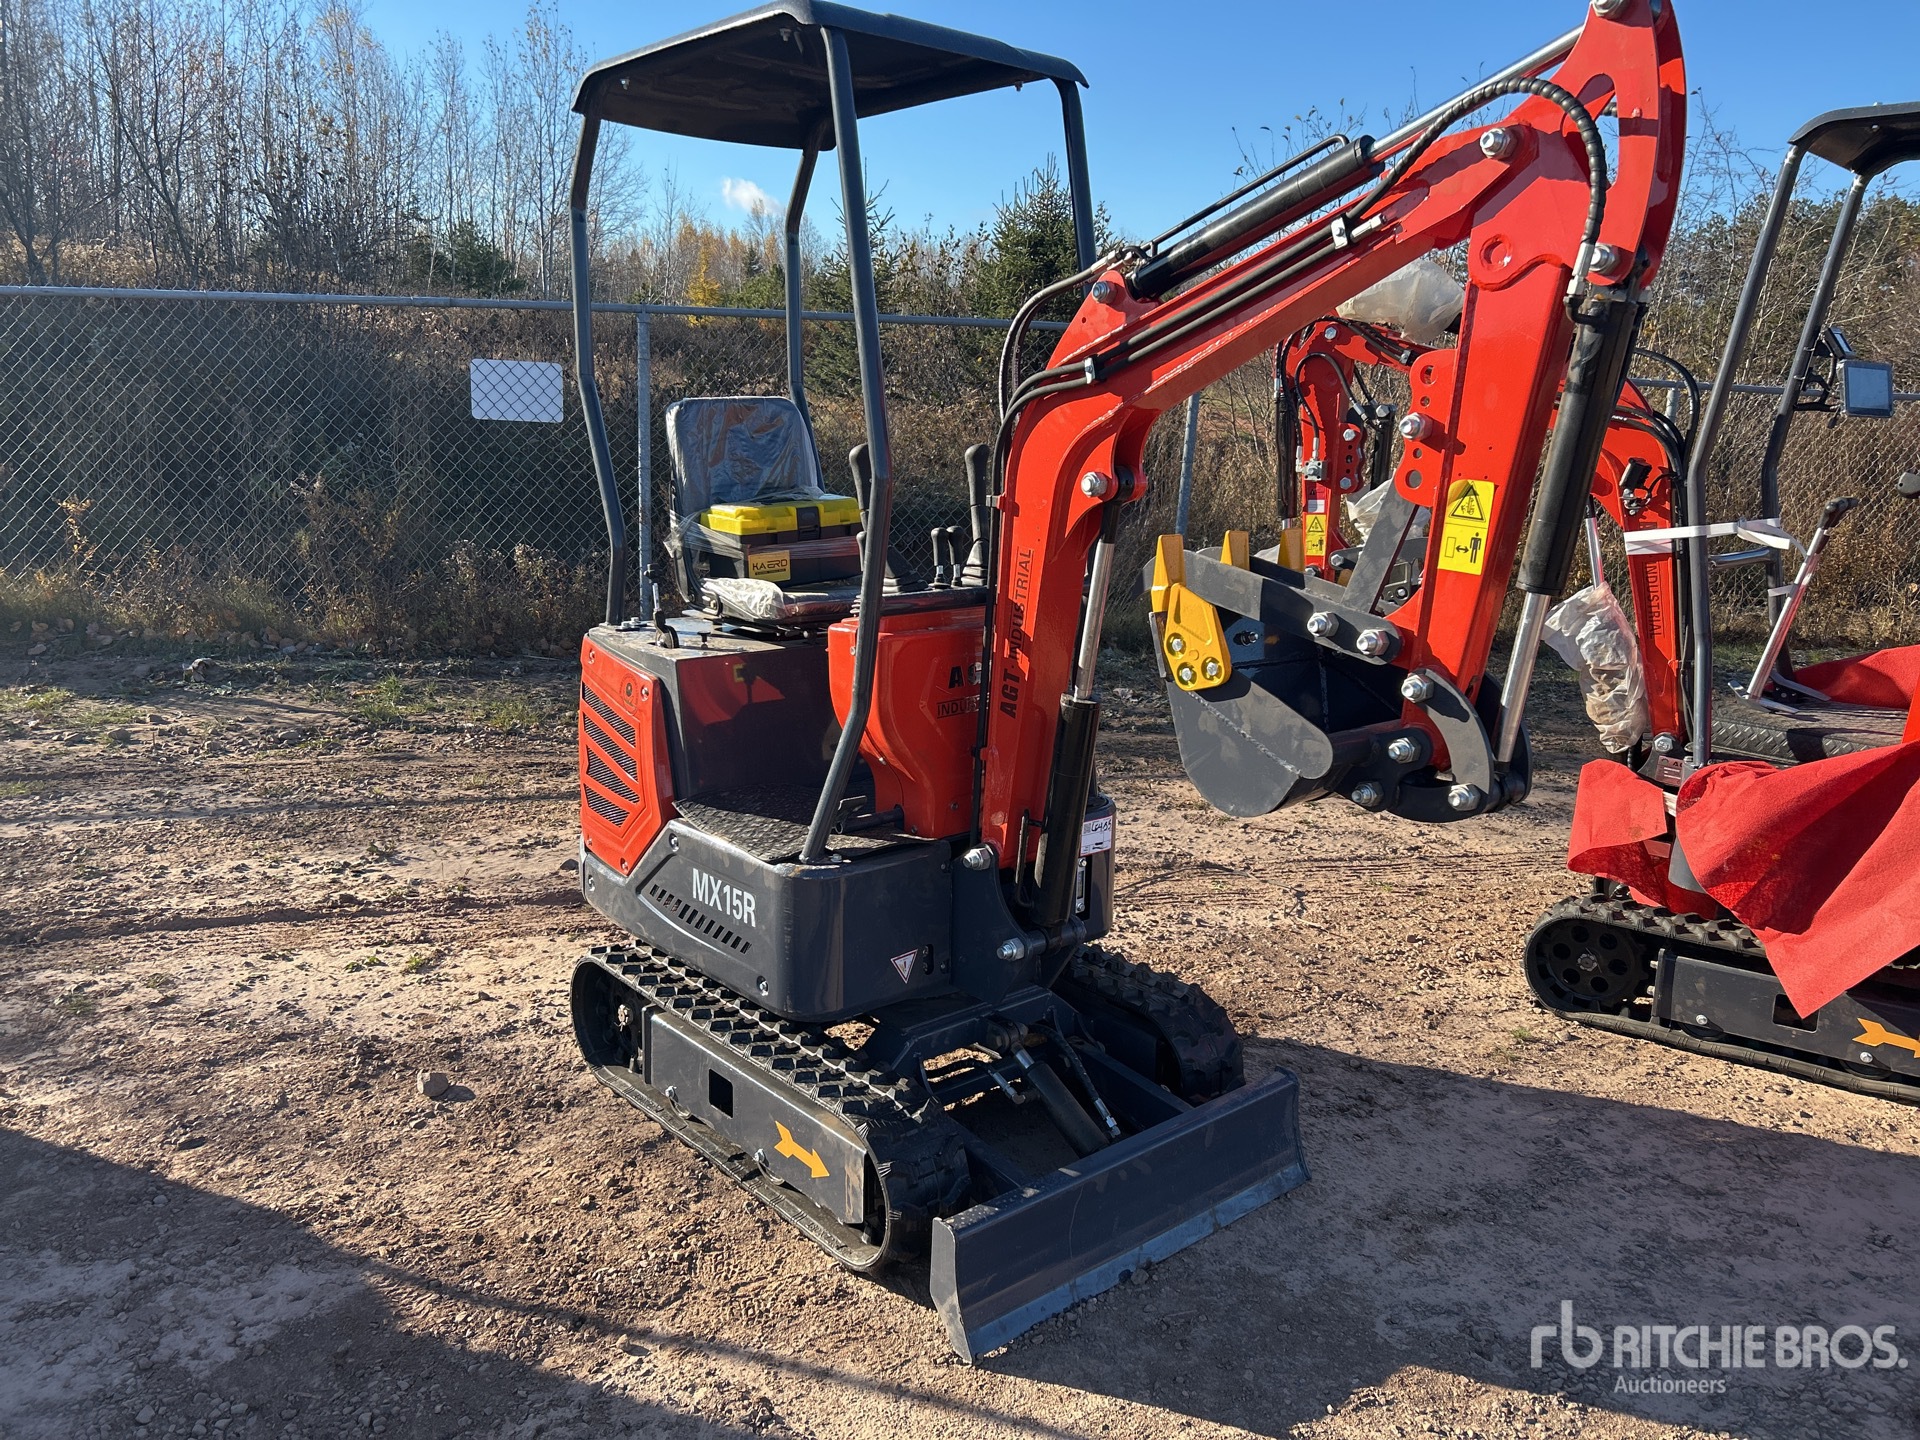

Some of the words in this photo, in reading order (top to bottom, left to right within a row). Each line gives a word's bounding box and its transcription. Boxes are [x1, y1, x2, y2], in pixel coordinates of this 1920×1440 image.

[1009, 549, 1032, 661] INDUSTRIAL
[948, 662, 982, 689] AG
[1000, 668, 1021, 720] AGT
[692, 867, 757, 928] MX15R
